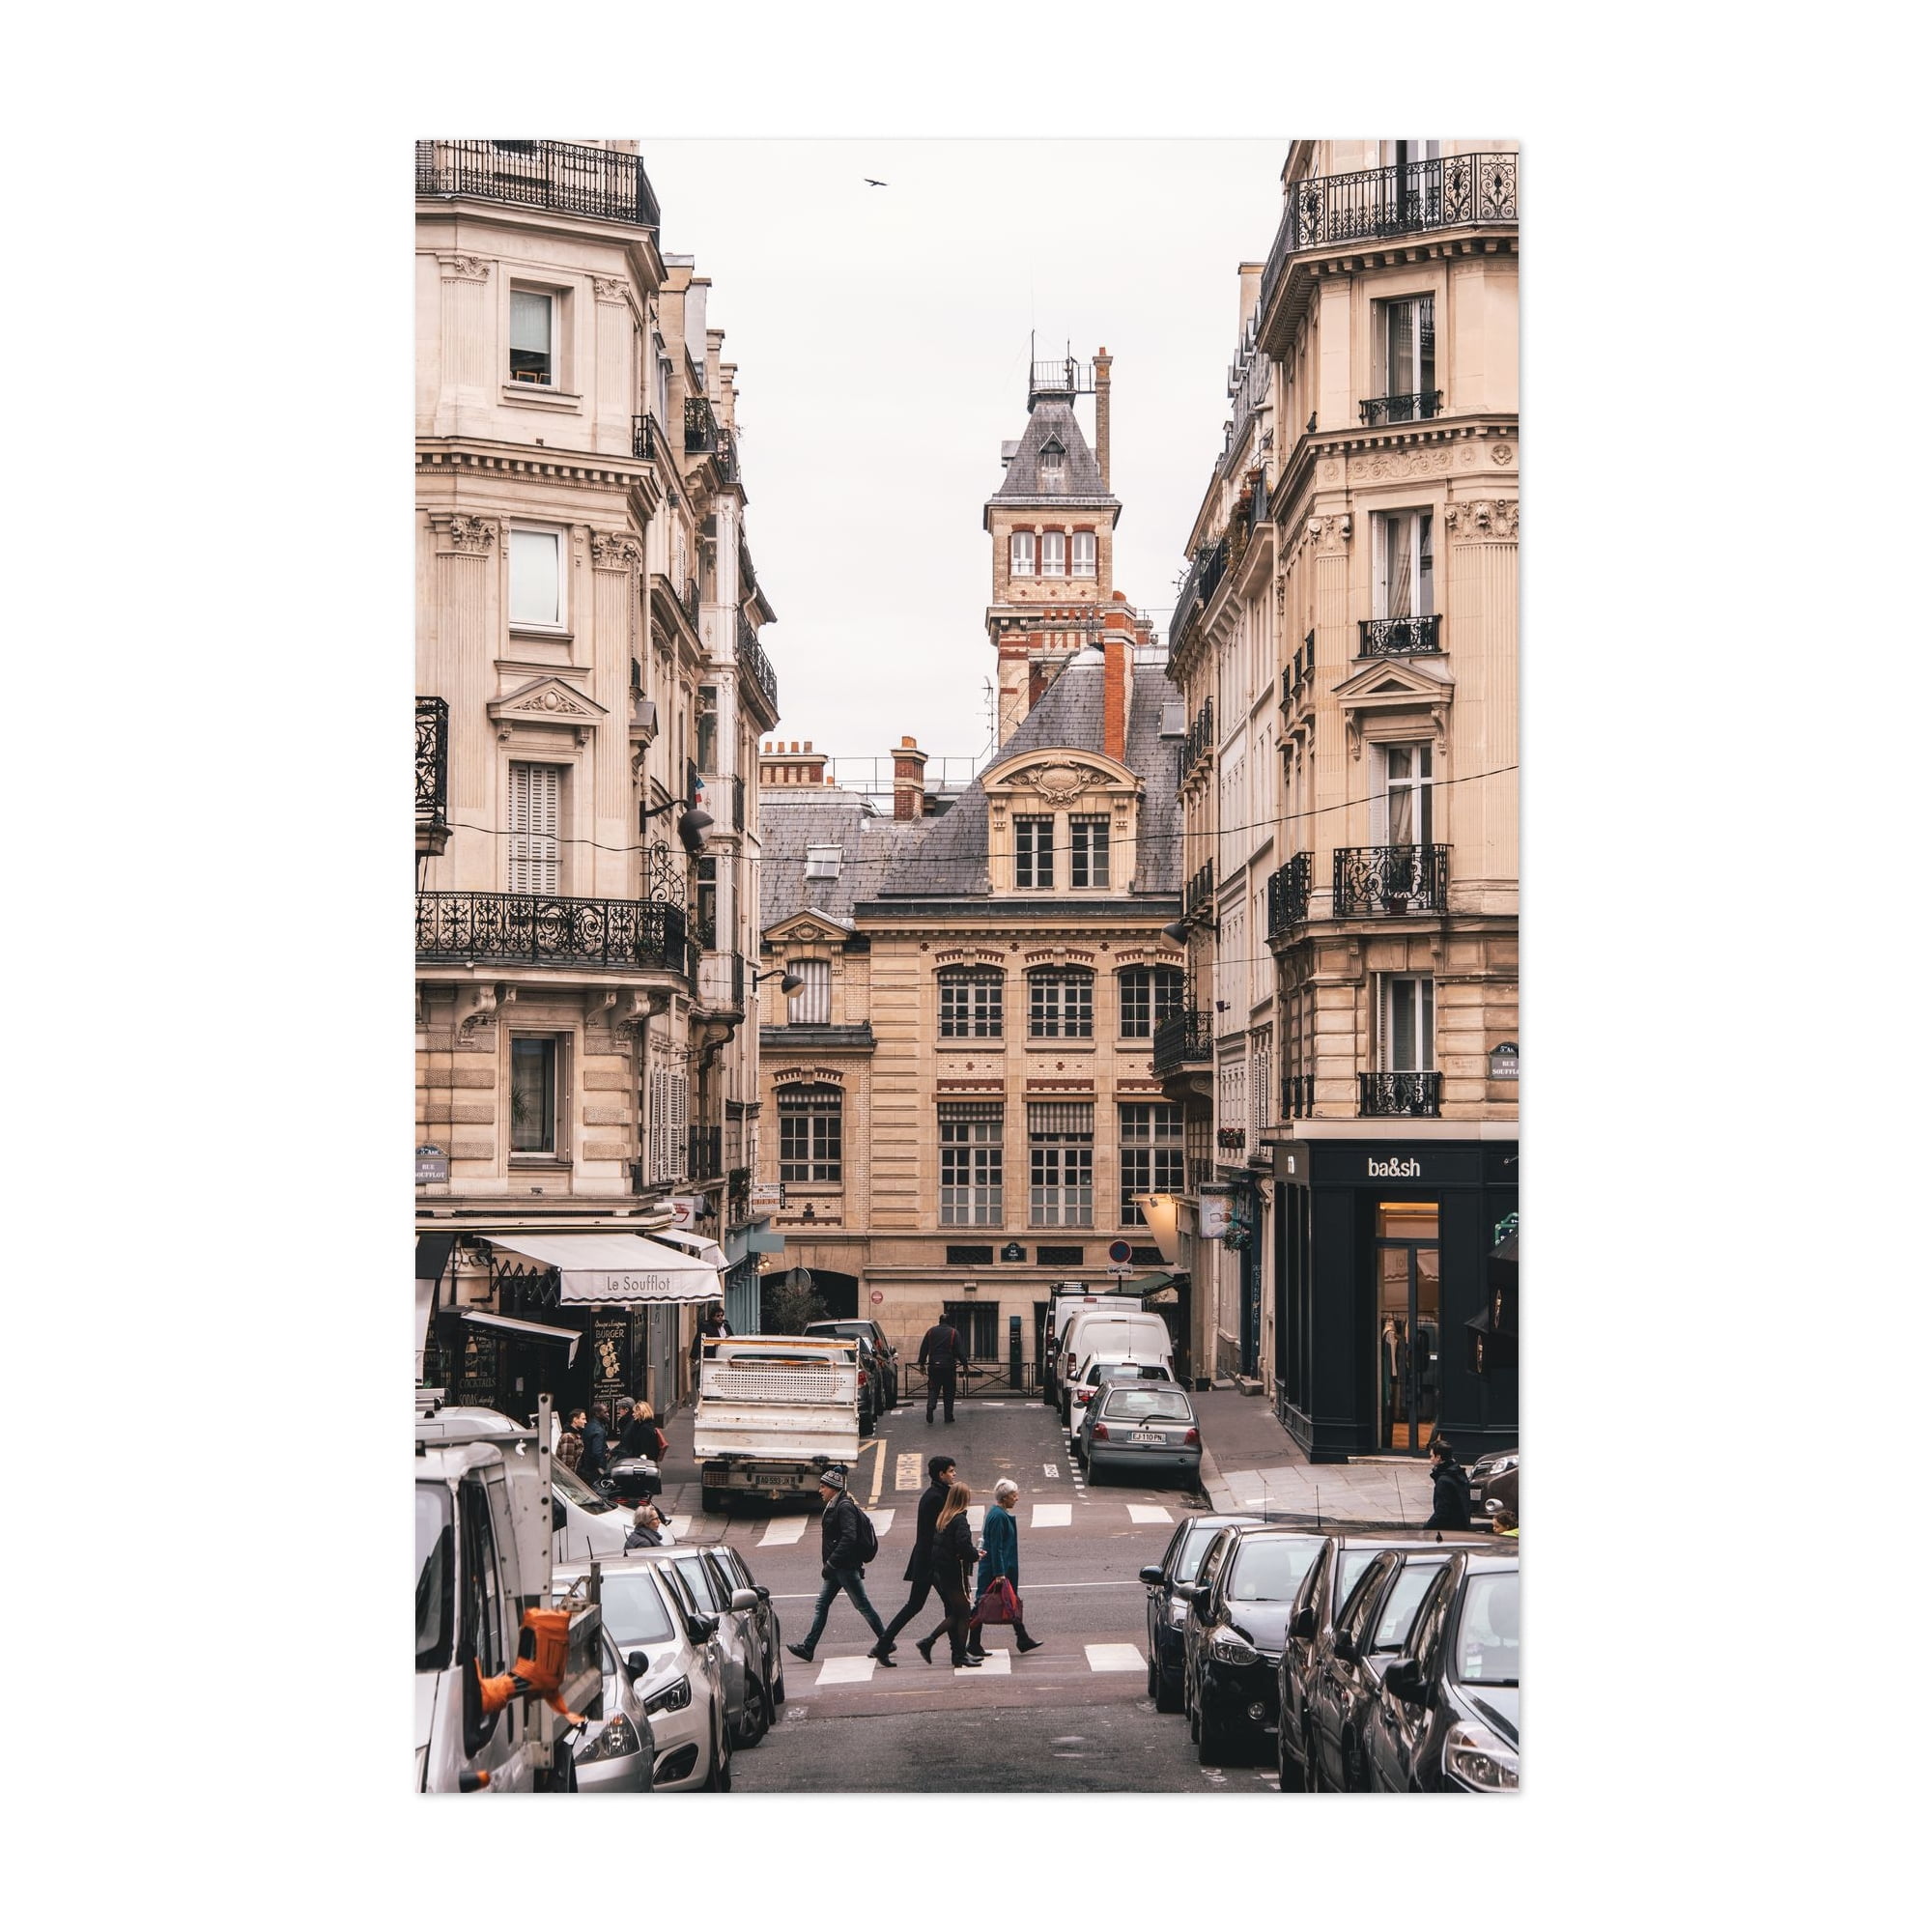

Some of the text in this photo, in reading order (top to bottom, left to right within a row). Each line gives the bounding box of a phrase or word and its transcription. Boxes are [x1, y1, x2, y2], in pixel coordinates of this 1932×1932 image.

[1368, 1157, 1420, 1177] ba&sh
[607, 1275, 670, 1291] Le Soufflot
[595, 1329, 625, 1339] BURGER
